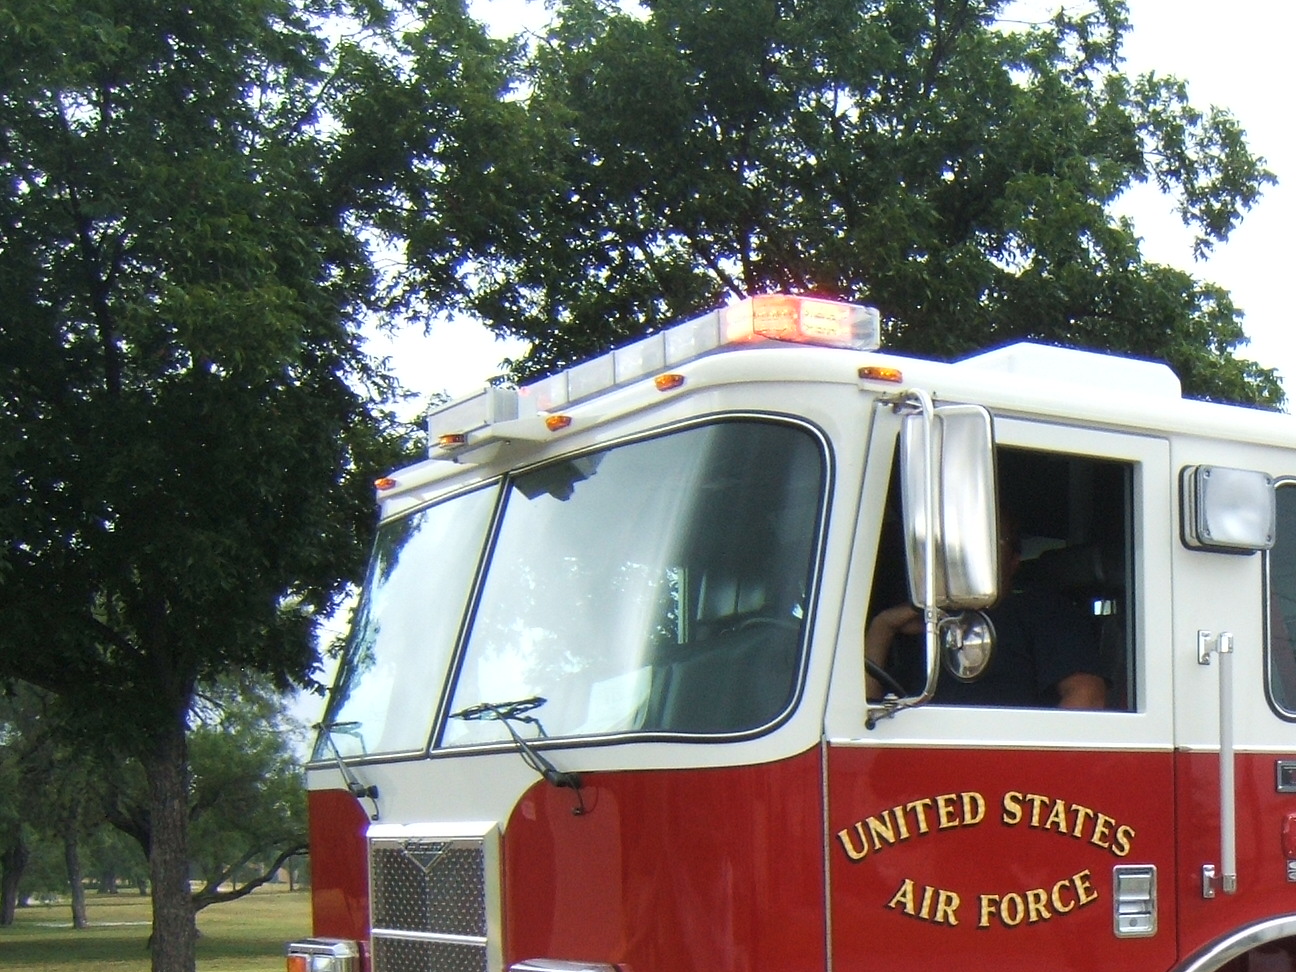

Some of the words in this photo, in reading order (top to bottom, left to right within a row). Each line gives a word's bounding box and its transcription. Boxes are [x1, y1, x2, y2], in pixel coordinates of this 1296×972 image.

[837, 791, 986, 860] UNITED
[1003, 791, 1136, 857] STATES
[888, 878, 961, 926] AIR
[979, 869, 1098, 928] FORCE
